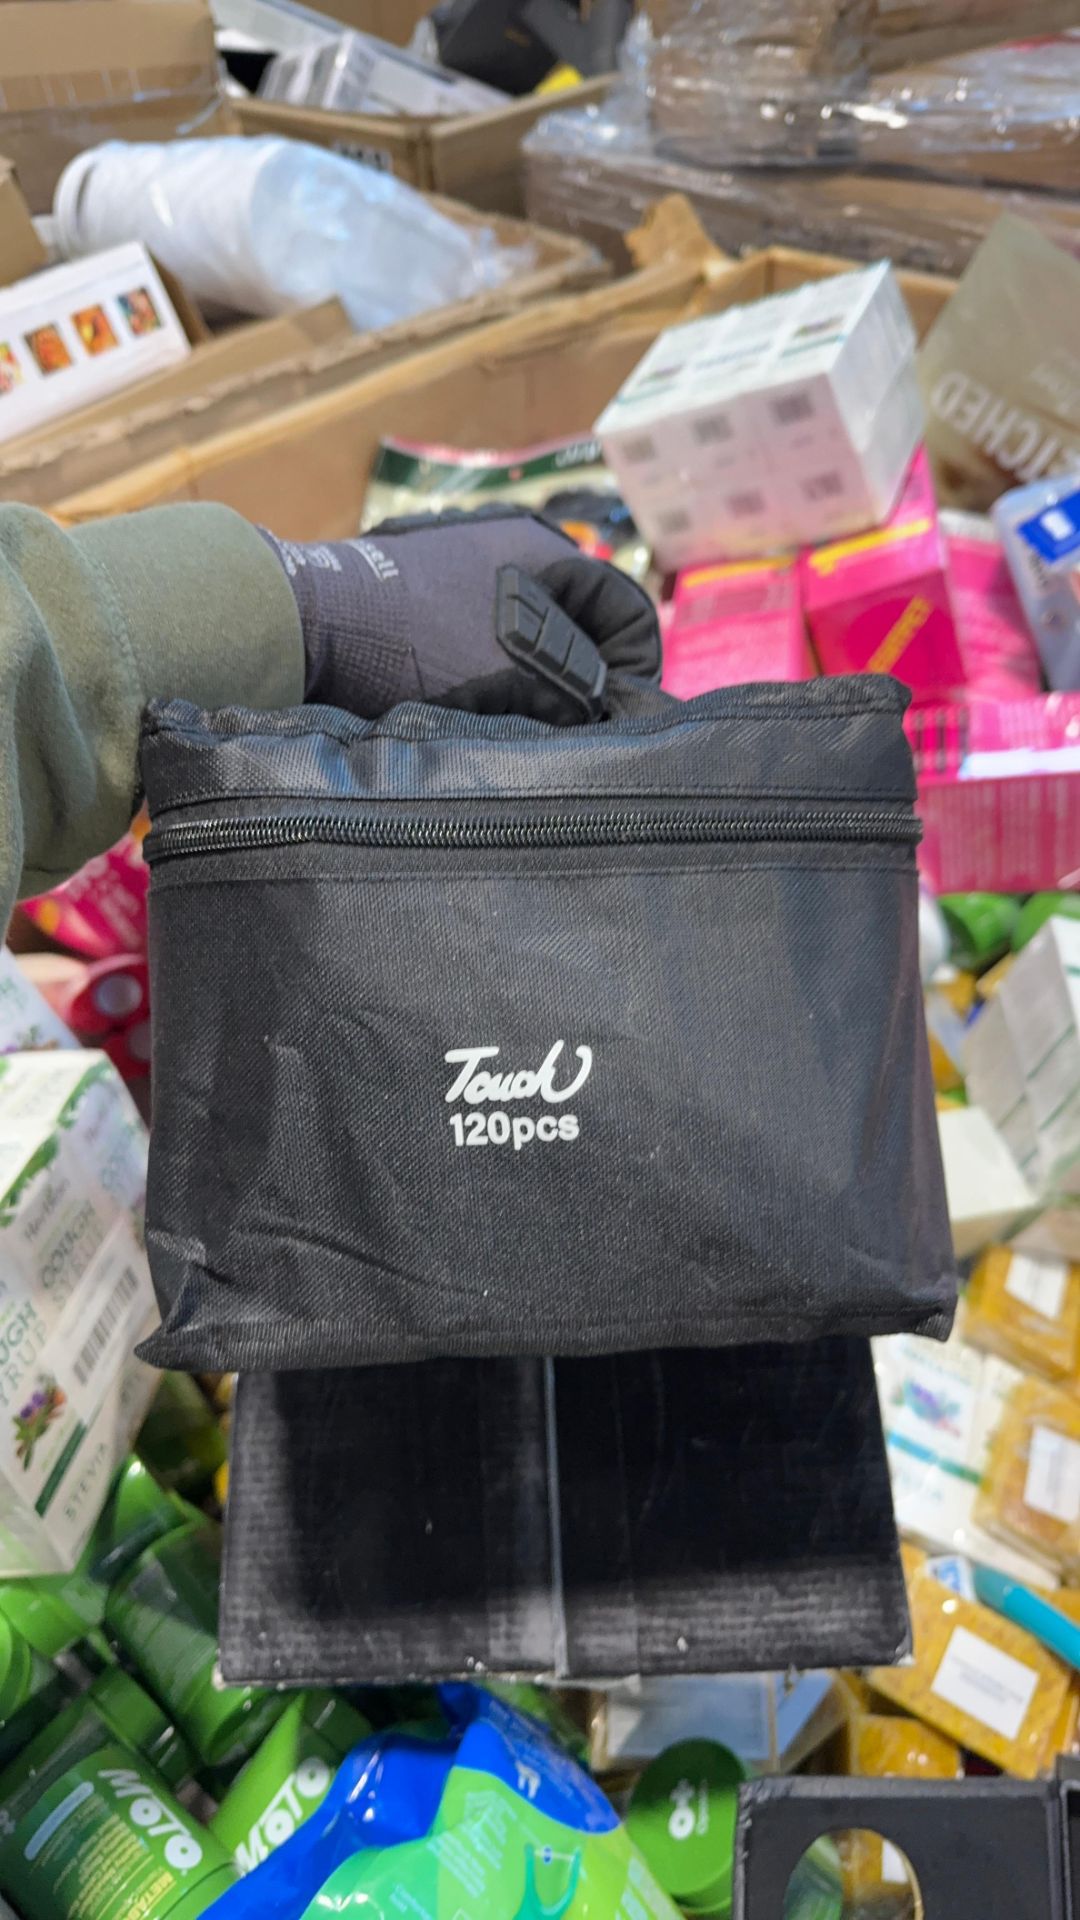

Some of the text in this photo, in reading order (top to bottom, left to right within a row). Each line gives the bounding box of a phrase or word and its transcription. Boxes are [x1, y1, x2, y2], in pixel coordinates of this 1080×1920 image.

[450, 1111, 580, 1150] 120pcs
[97, 1768, 203, 1860] MOTO
[234, 1756, 331, 1879] MOTO
